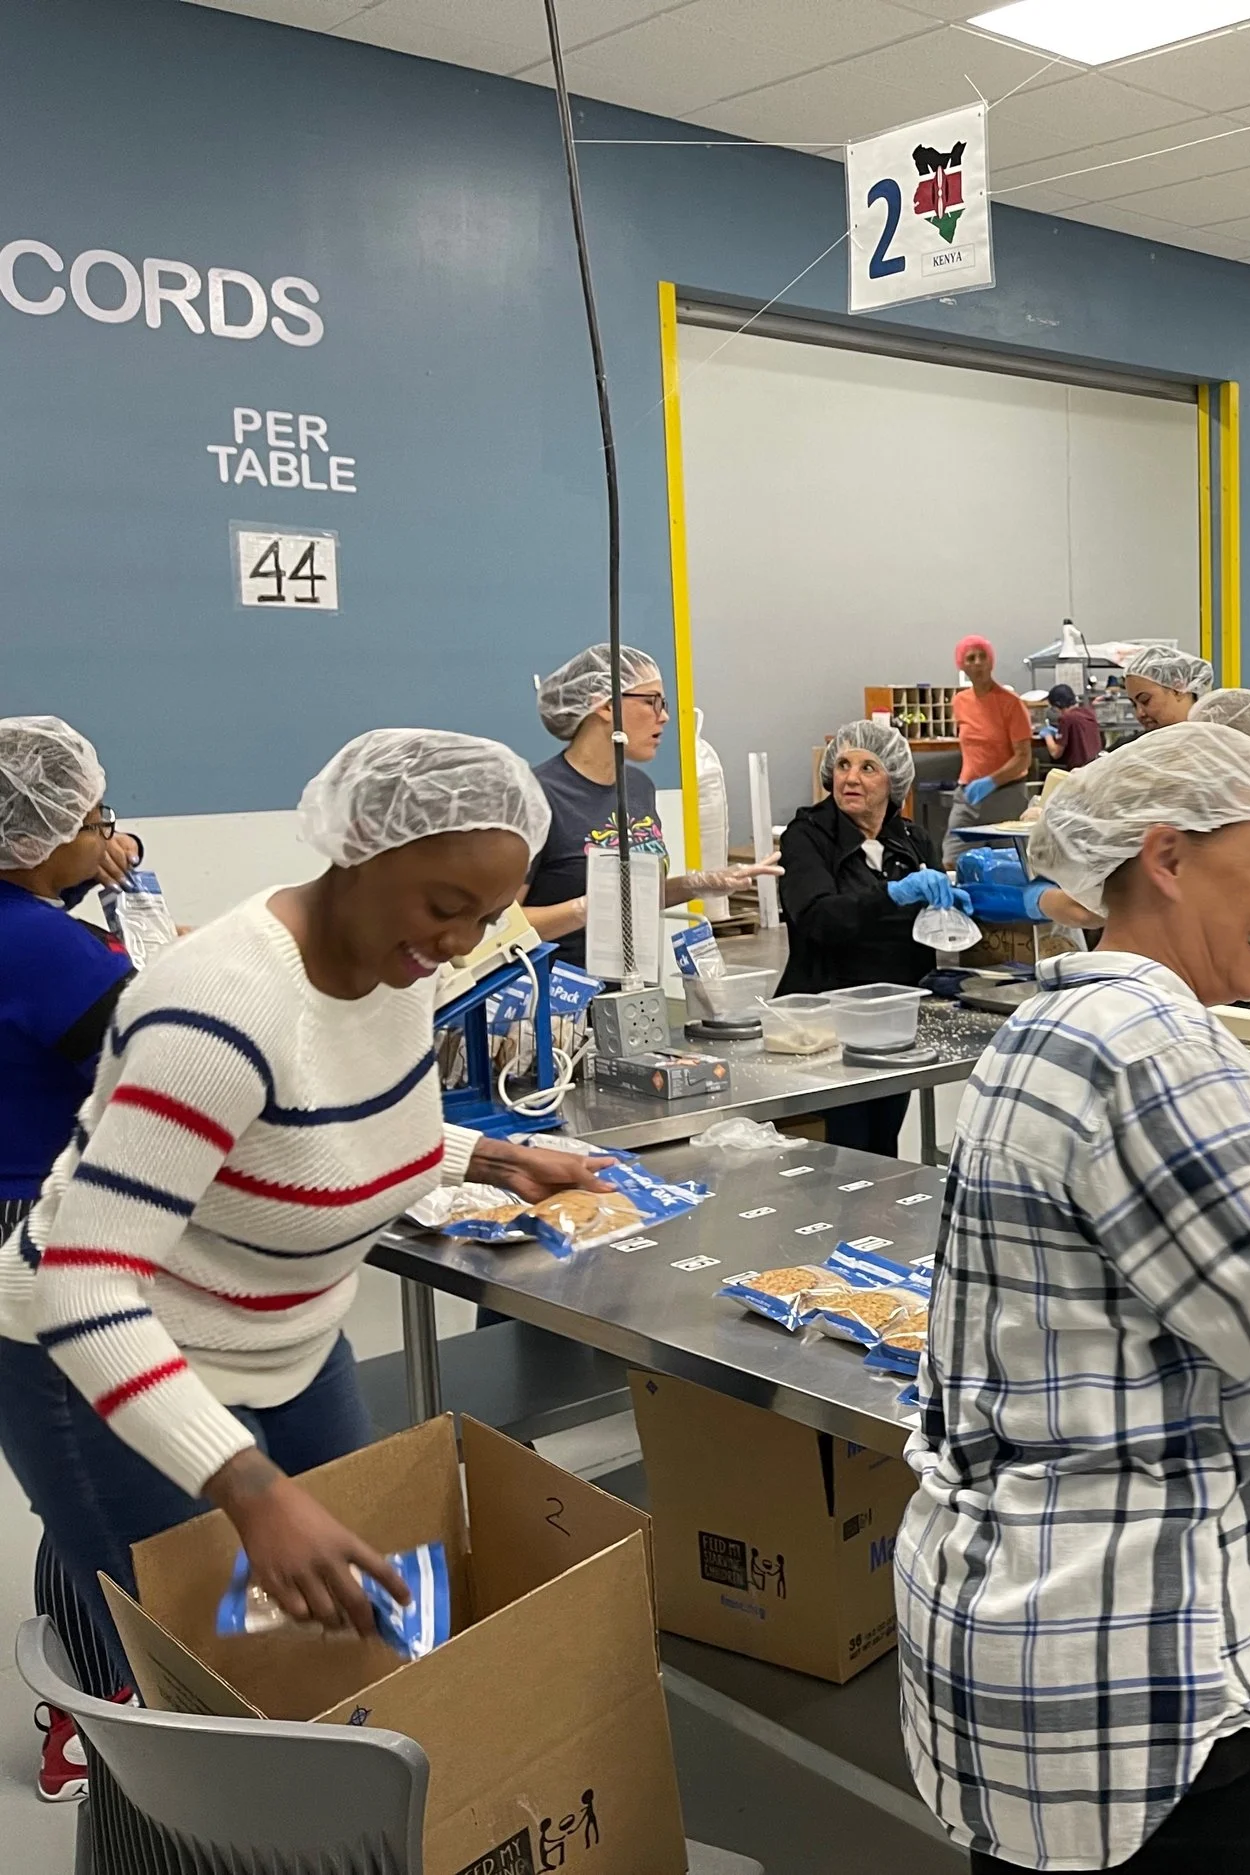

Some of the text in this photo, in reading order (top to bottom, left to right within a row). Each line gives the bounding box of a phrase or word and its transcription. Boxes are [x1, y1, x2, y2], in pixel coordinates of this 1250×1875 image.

[867, 178, 963, 280] 2 KENYA
[0, 239, 325, 347] CORDS
[233, 407, 329, 453] PER
[206, 444, 357, 493] TABLE
[249, 537, 328, 604] 44
[545, 1495, 571, 1537] 2
[702, 1534, 727, 1554] FEED
[500, 1837, 522, 1867] MY
